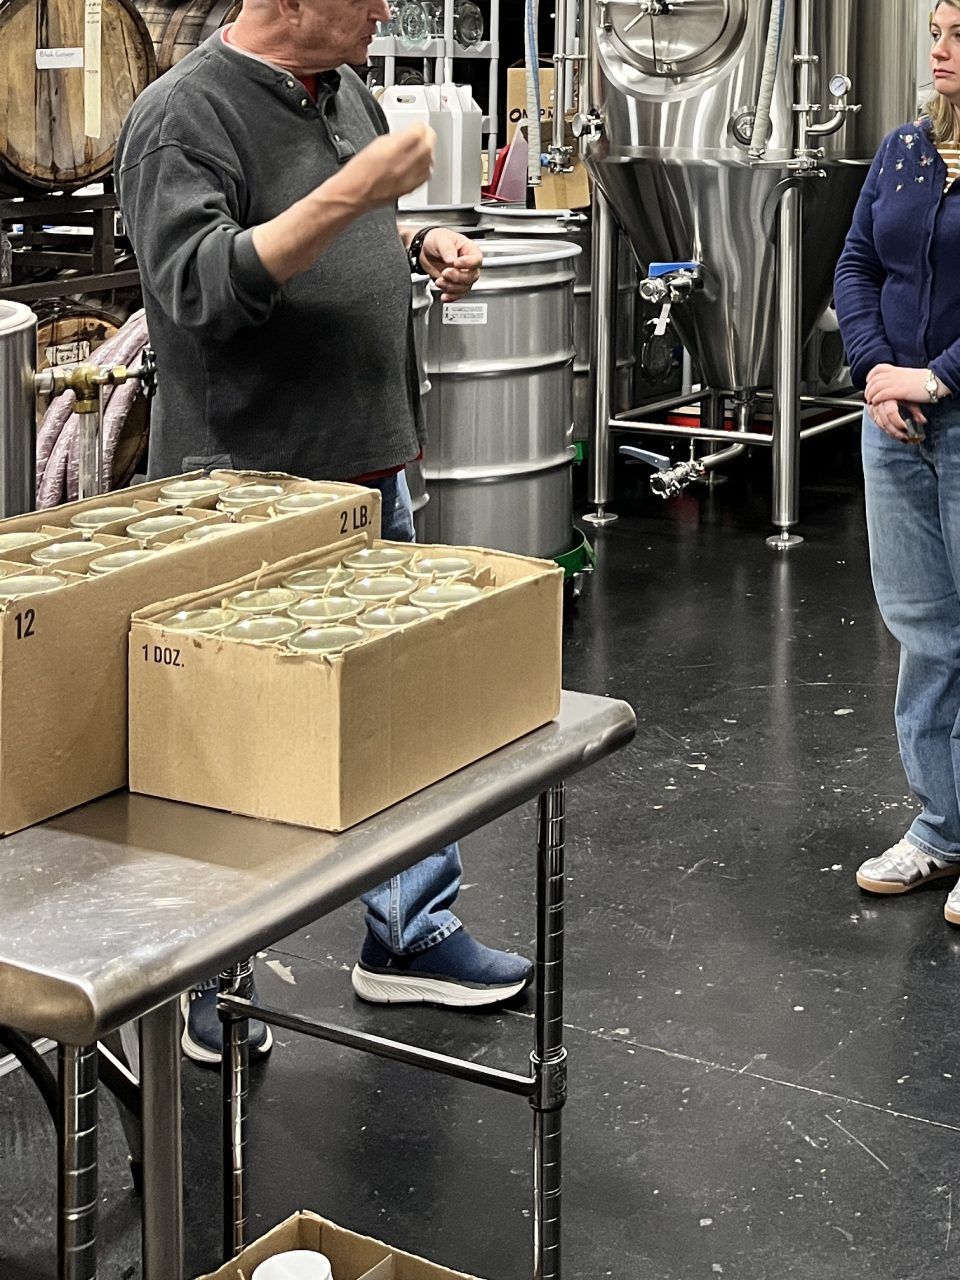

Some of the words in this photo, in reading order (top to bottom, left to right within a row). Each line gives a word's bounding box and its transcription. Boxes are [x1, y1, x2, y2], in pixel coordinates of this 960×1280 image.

[340, 510, 348, 535] 2
[353, 505, 372, 530] LB.
[14, 608, 35, 640] 12
[141, 643, 149, 662] 1
[153, 645, 186, 668] DOZ.
